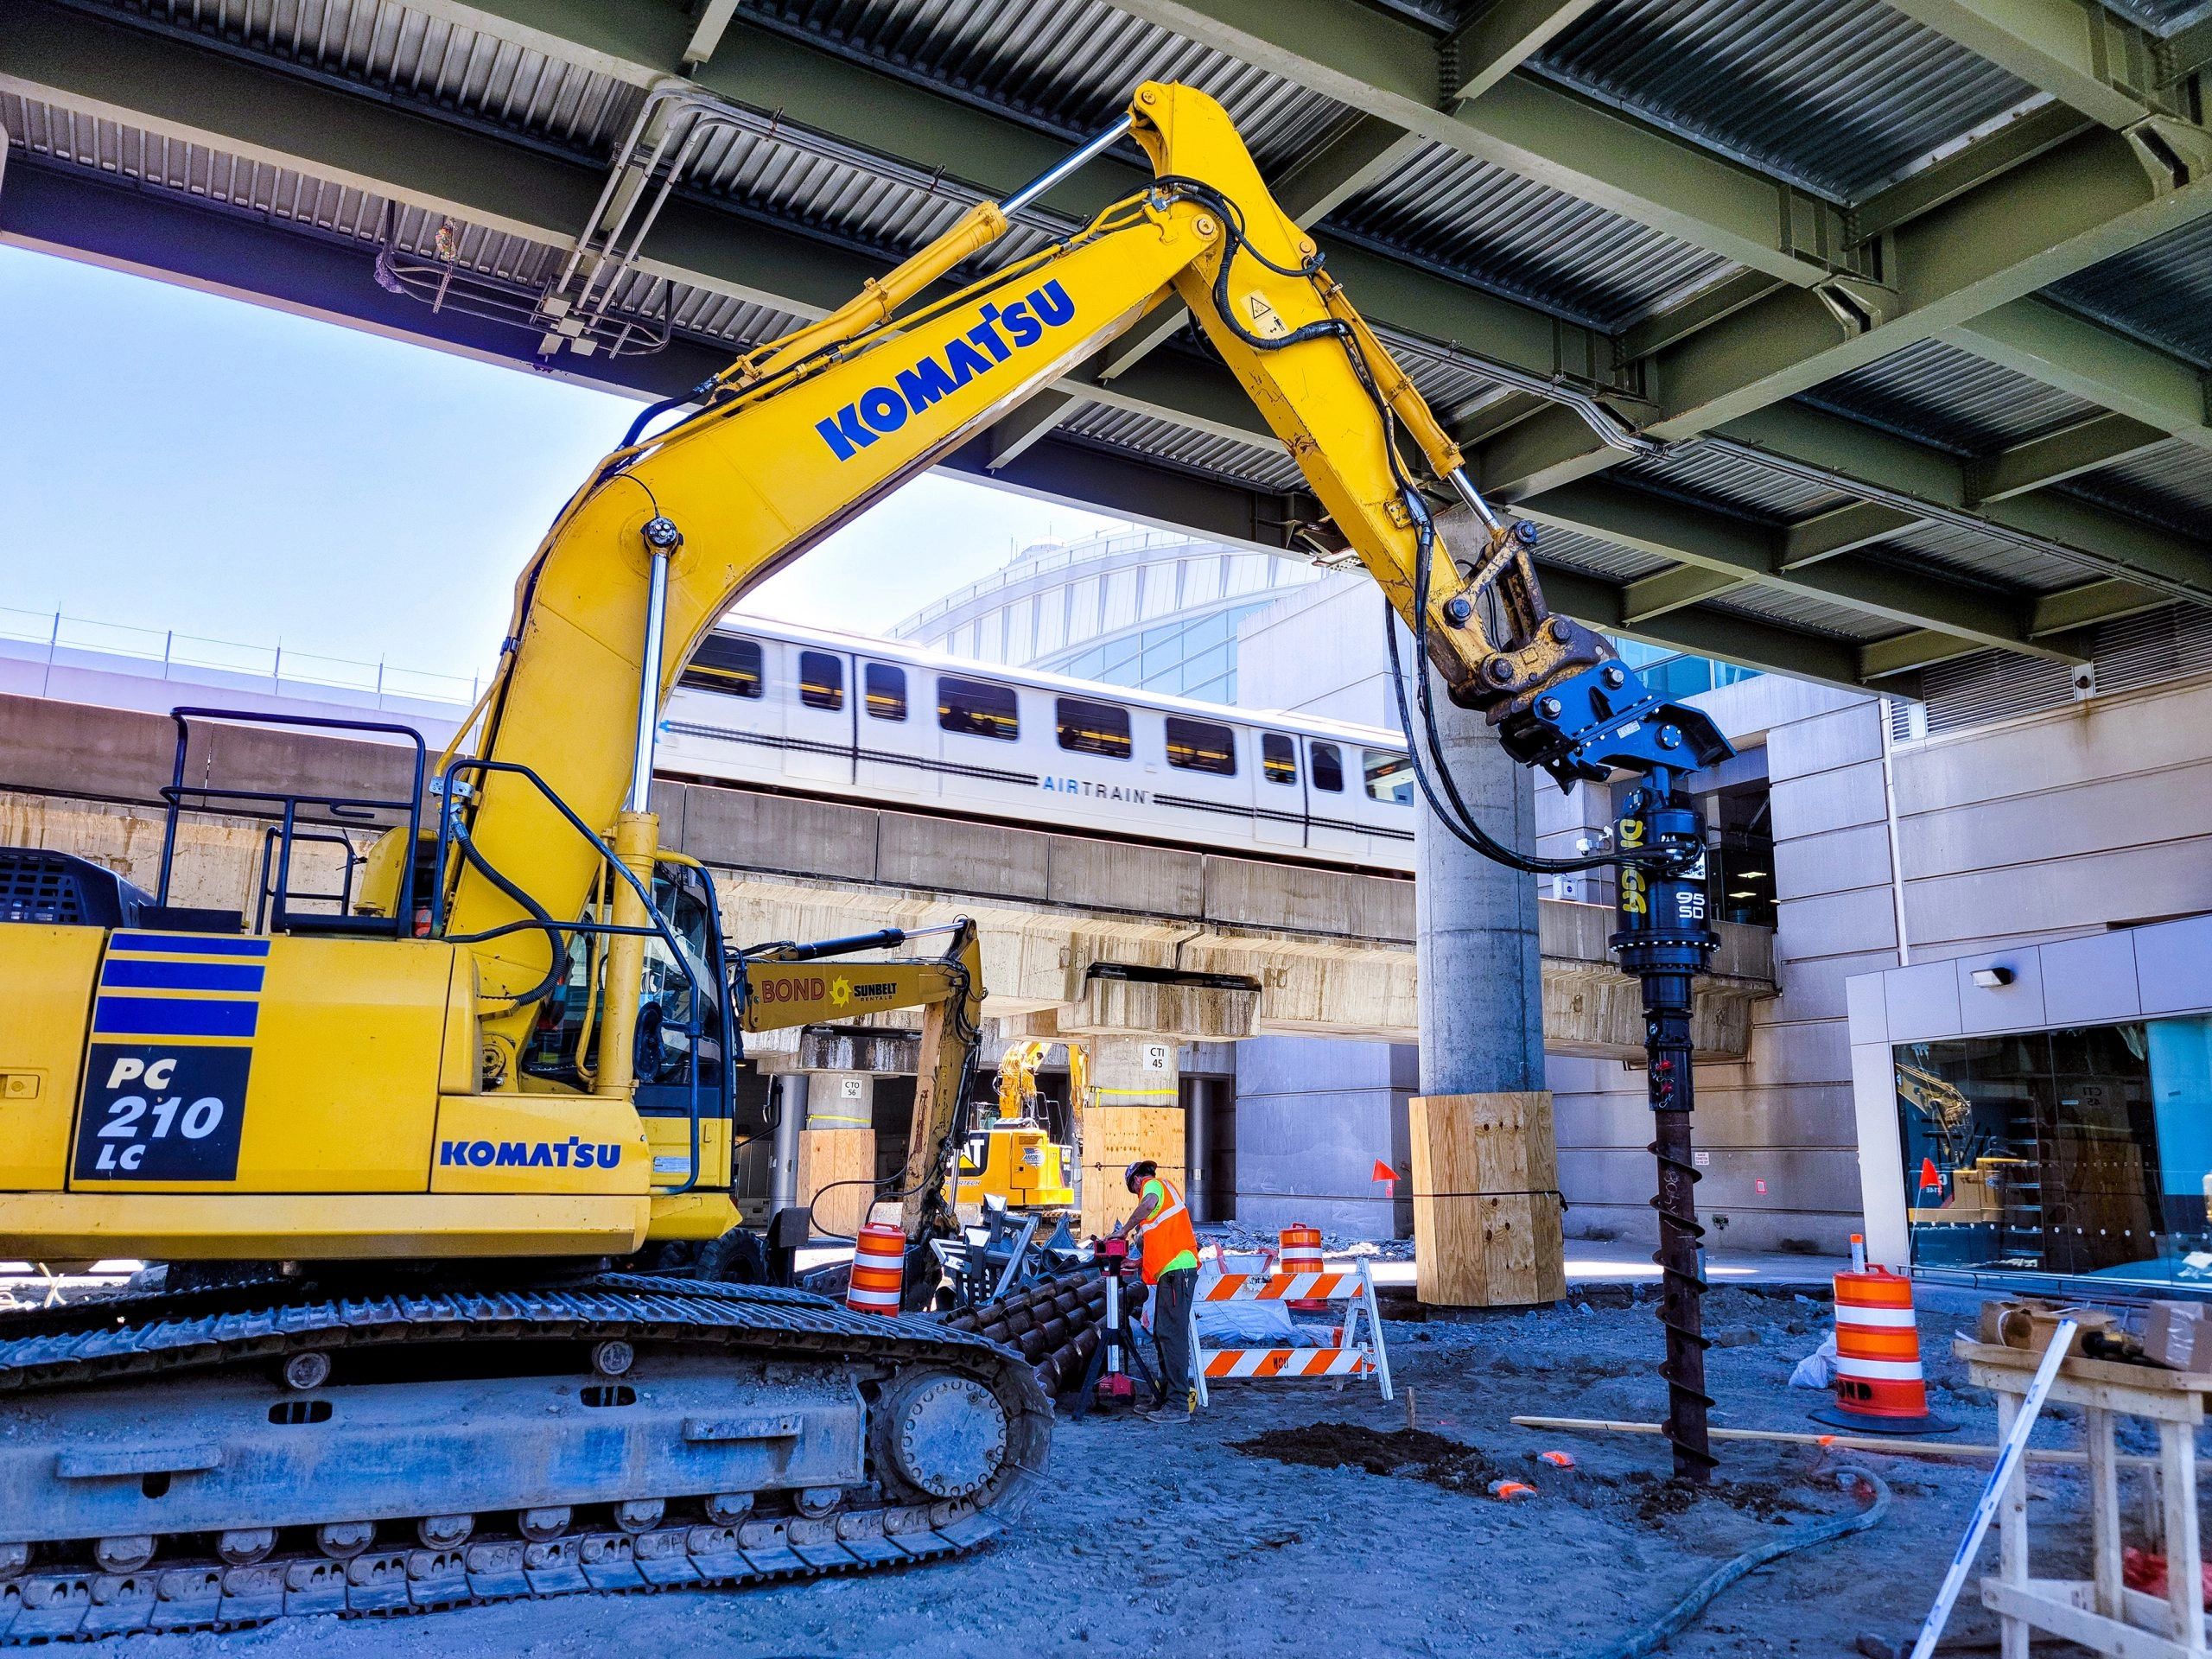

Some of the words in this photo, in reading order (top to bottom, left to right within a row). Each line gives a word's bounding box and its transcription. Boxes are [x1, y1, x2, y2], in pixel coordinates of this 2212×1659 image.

[815, 278, 1075, 462] KOMATSU
[1042, 776, 1147, 804] AIRTRAIN
[1619, 818, 1647, 914] DIGA
[1675, 892, 1706, 906] 95
[1679, 906, 1704, 919] SD
[761, 977, 826, 1003] BOND
[854, 982, 898, 997] SUNBELT
[1150, 1047, 1165, 1057] CTI
[1152, 1058, 1163, 1068] 45
[105, 1058, 177, 1090] PC
[97, 1096, 224, 1139] 210
[95, 1144, 146, 1170] LC
[440, 1135, 621, 1169] KOMATSU
